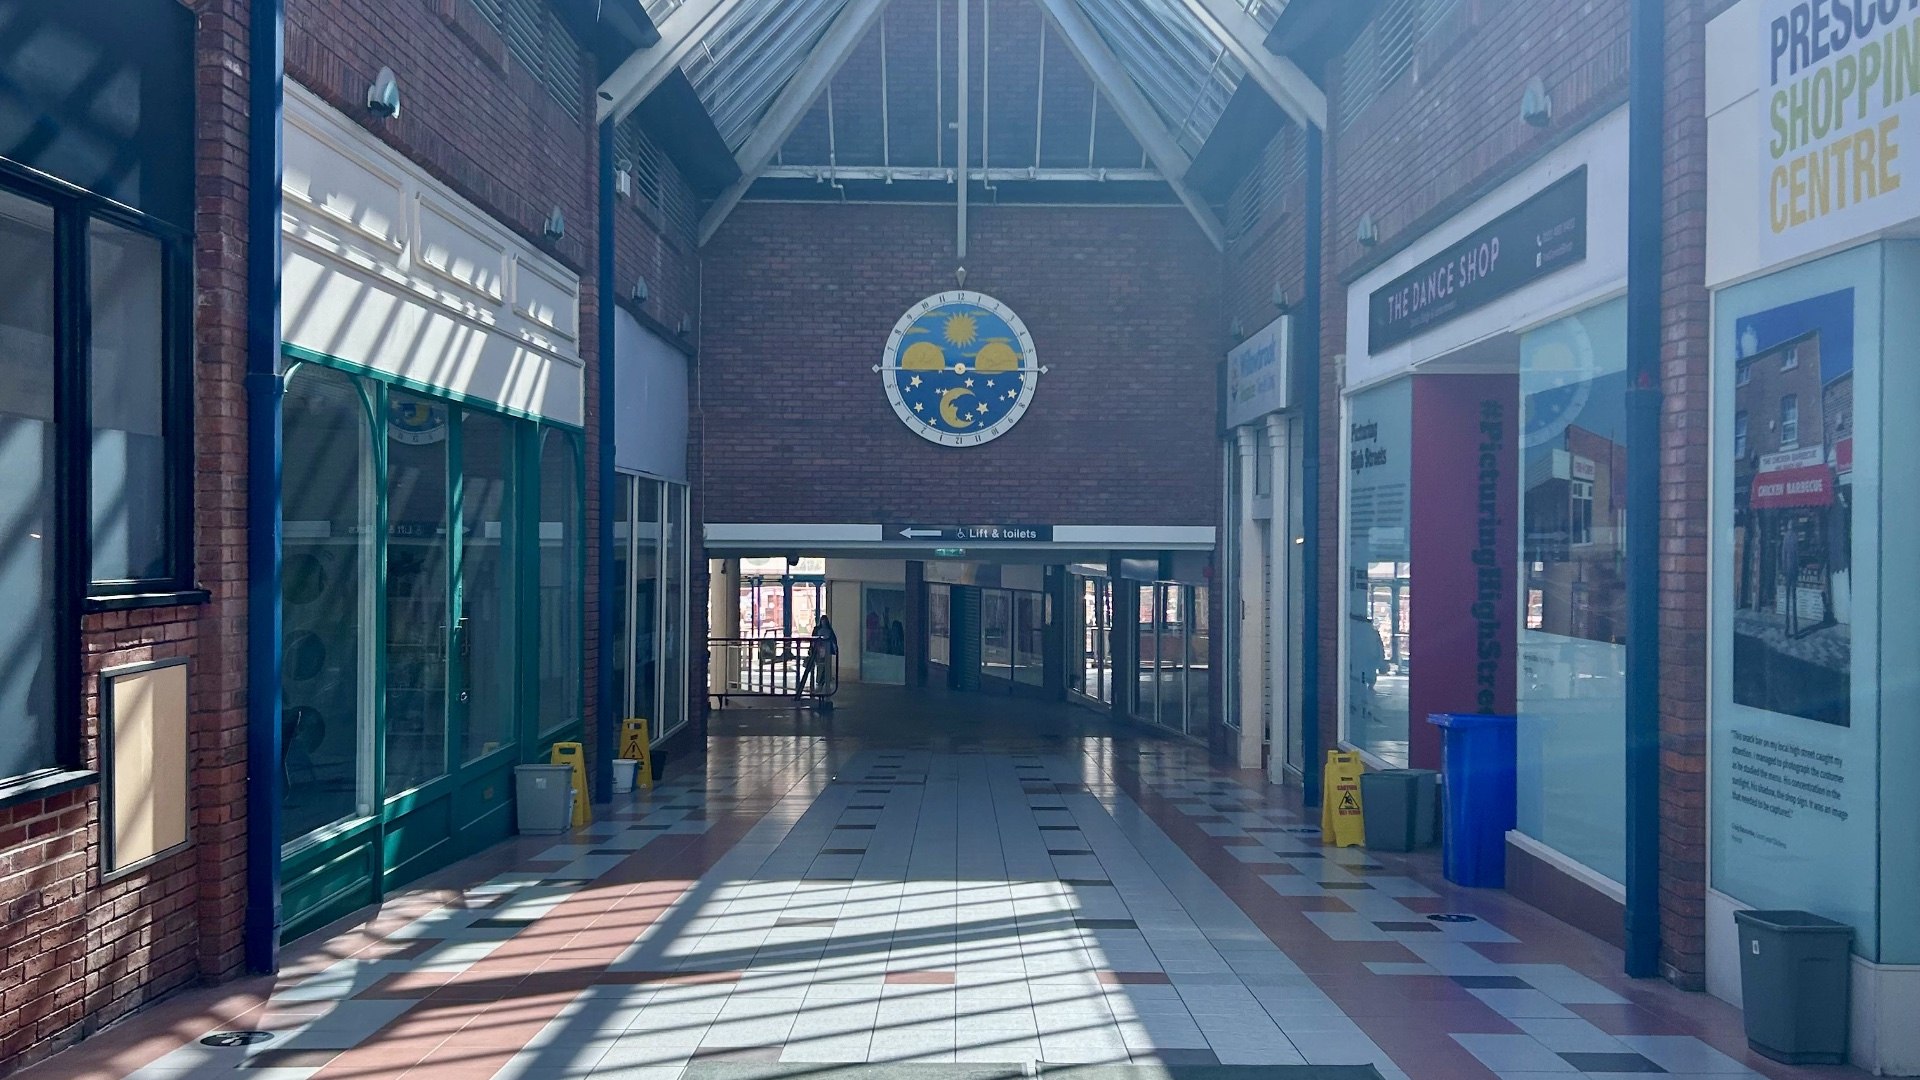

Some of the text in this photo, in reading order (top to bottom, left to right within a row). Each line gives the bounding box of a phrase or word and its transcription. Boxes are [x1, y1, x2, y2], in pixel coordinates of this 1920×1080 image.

[1770, 114, 1900, 234] CENTRE
[1388, 286, 1409, 324] THE
[1412, 261, 1454, 313] DANCE
[1459, 237, 1500, 288] SHOP
[922, 302, 929, 310] 10
[1758, 479, 1823, 497] CHICKEN BARBECUE
[969, 528, 1037, 539] Lift & toilets
